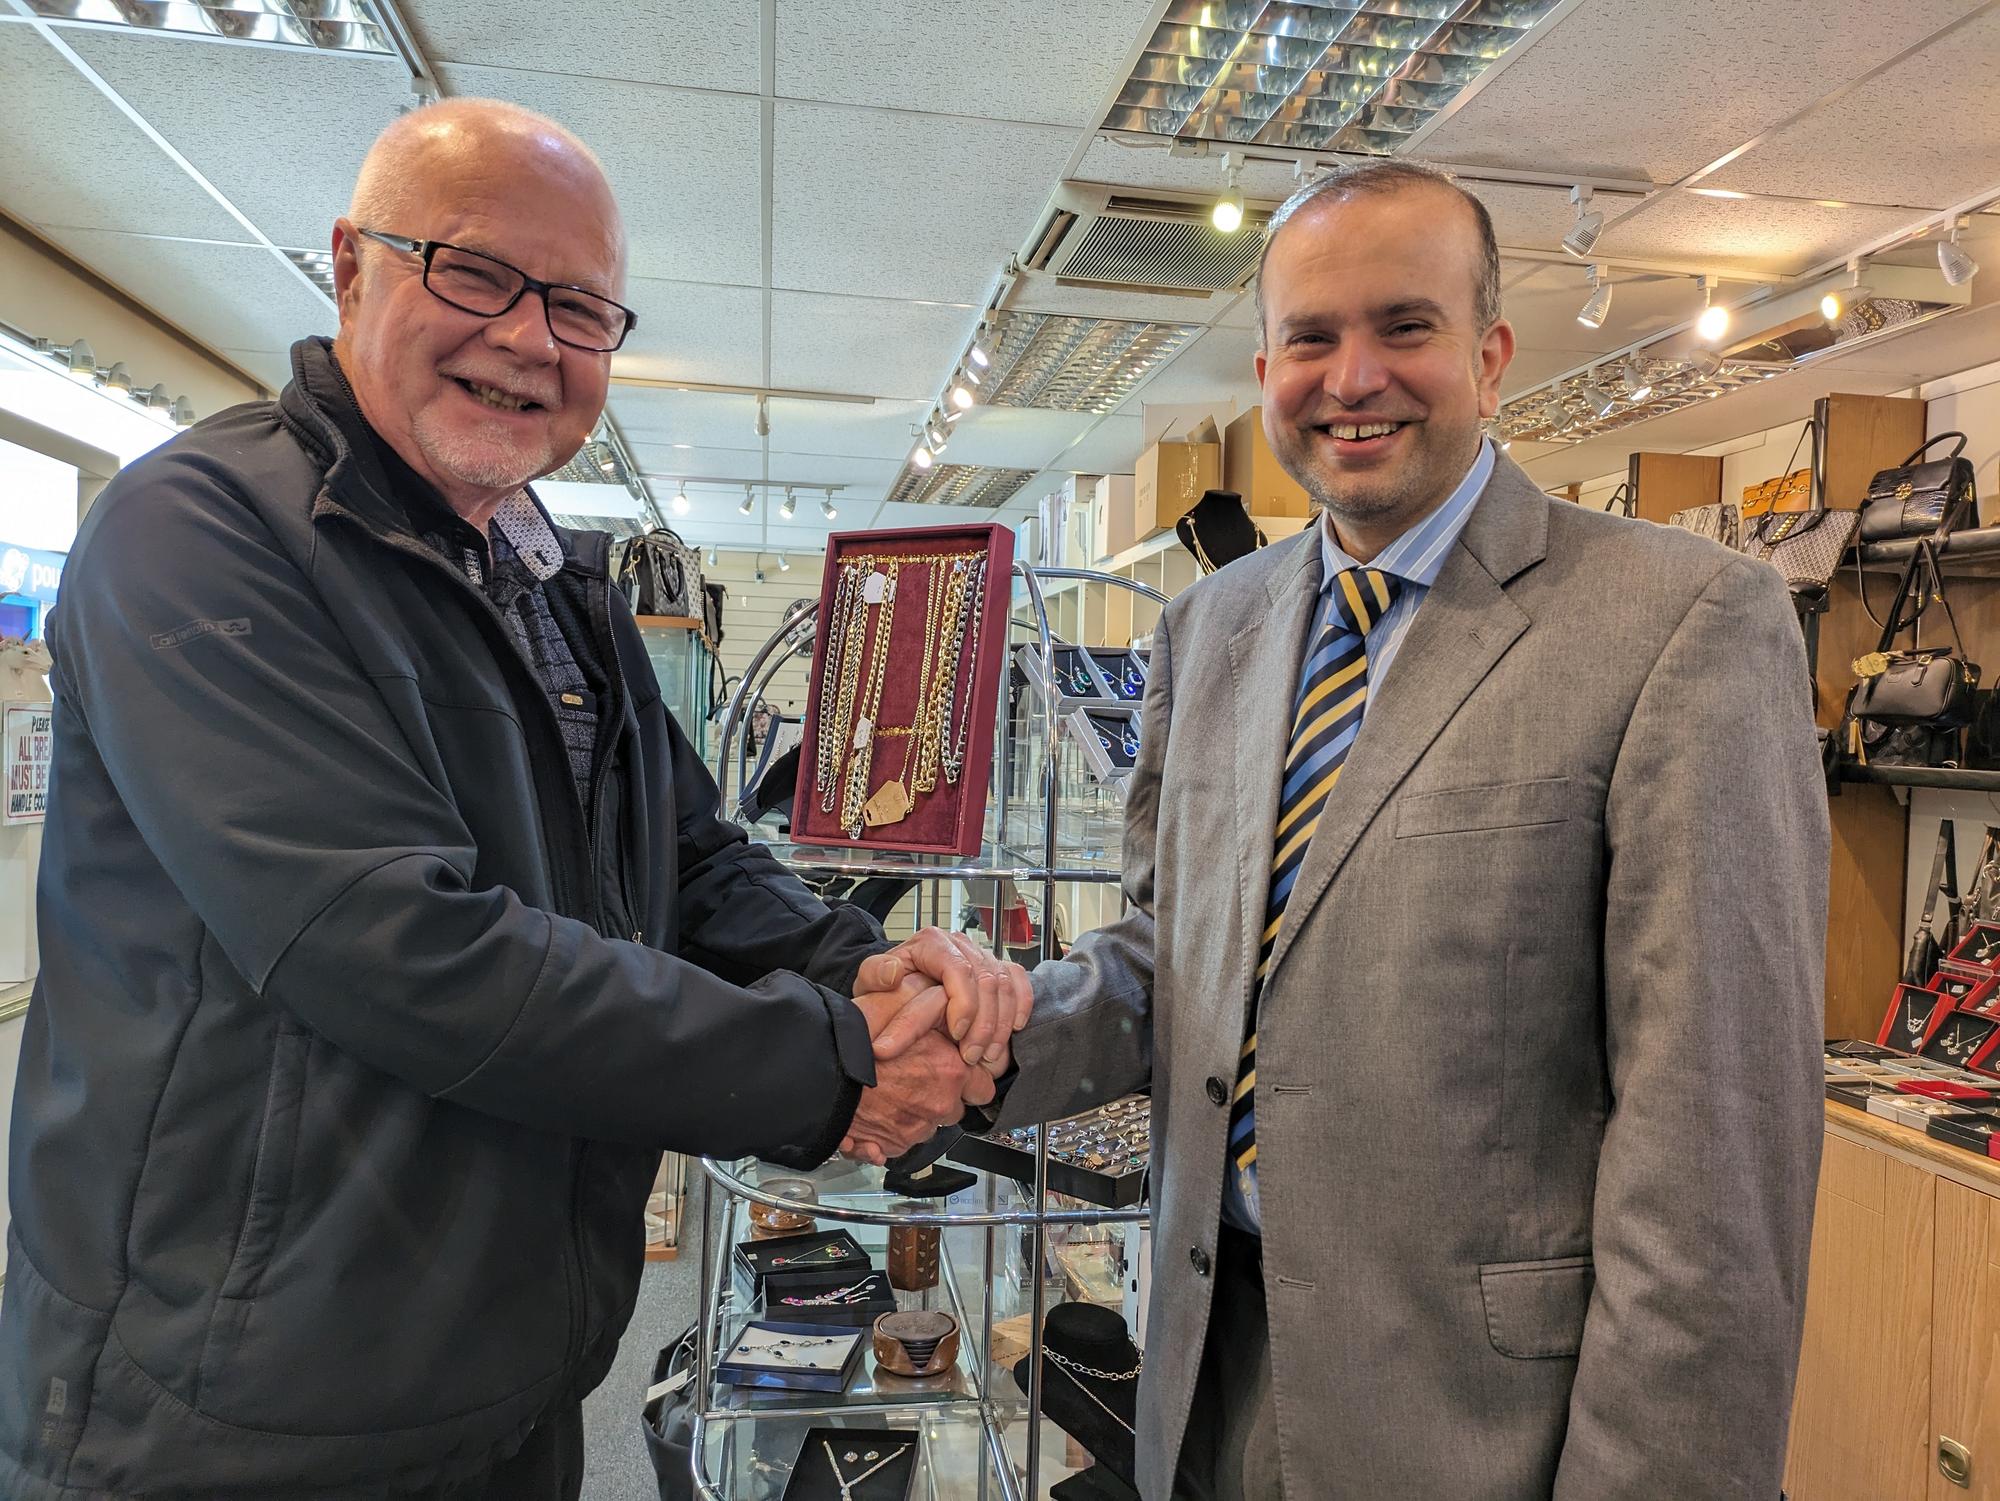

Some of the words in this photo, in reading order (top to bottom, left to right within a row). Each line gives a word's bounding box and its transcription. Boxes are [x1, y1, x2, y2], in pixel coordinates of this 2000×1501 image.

[19, 735, 32, 761] ALL
[11, 764, 33, 790] MUST
[36, 764, 47, 789] BE
[11, 793, 32, 813] HANDLE
[34, 793, 48, 811] GOO
